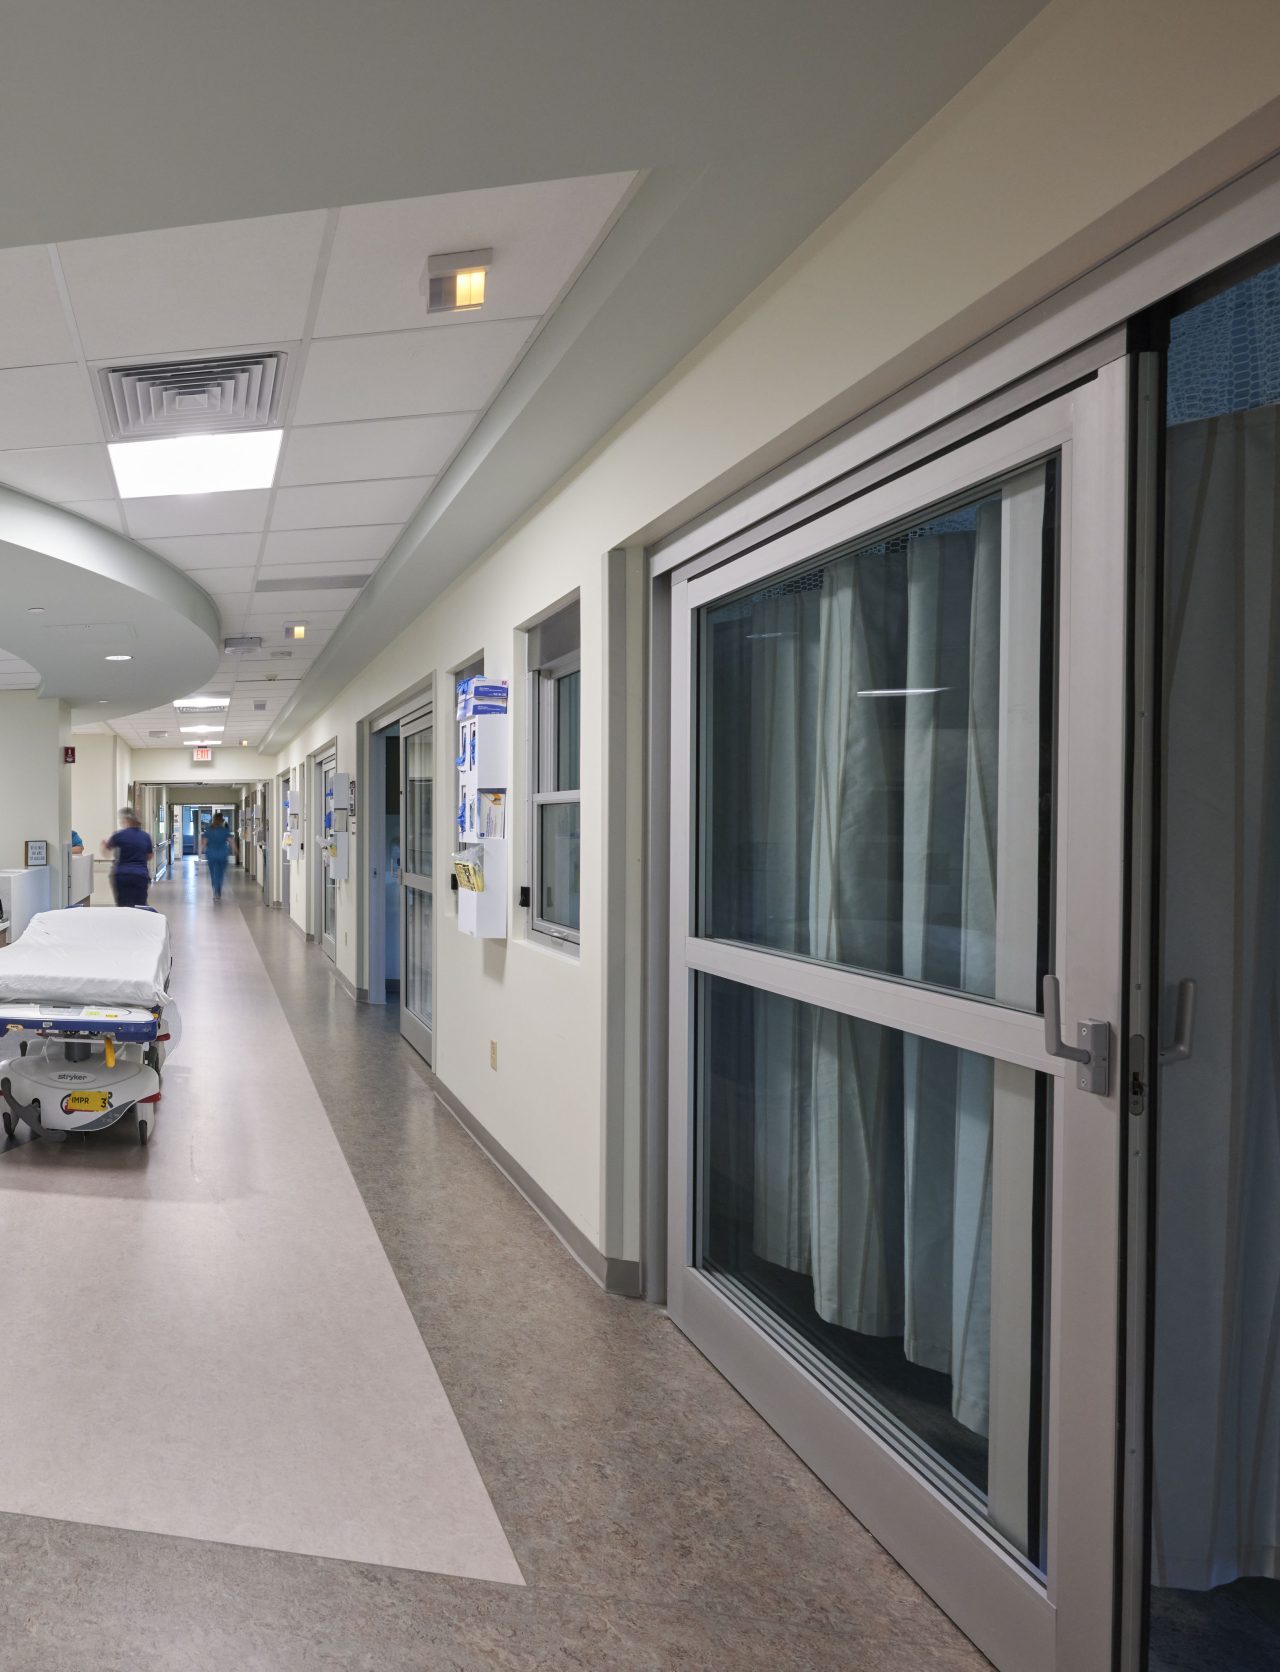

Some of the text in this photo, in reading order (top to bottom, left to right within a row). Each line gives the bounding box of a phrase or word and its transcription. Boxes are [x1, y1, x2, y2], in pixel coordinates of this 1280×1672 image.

[196, 749, 209, 759] EXIT
[57, 1073, 88, 1081] stryker
[71, 1096, 107, 1108] IMPR 3
